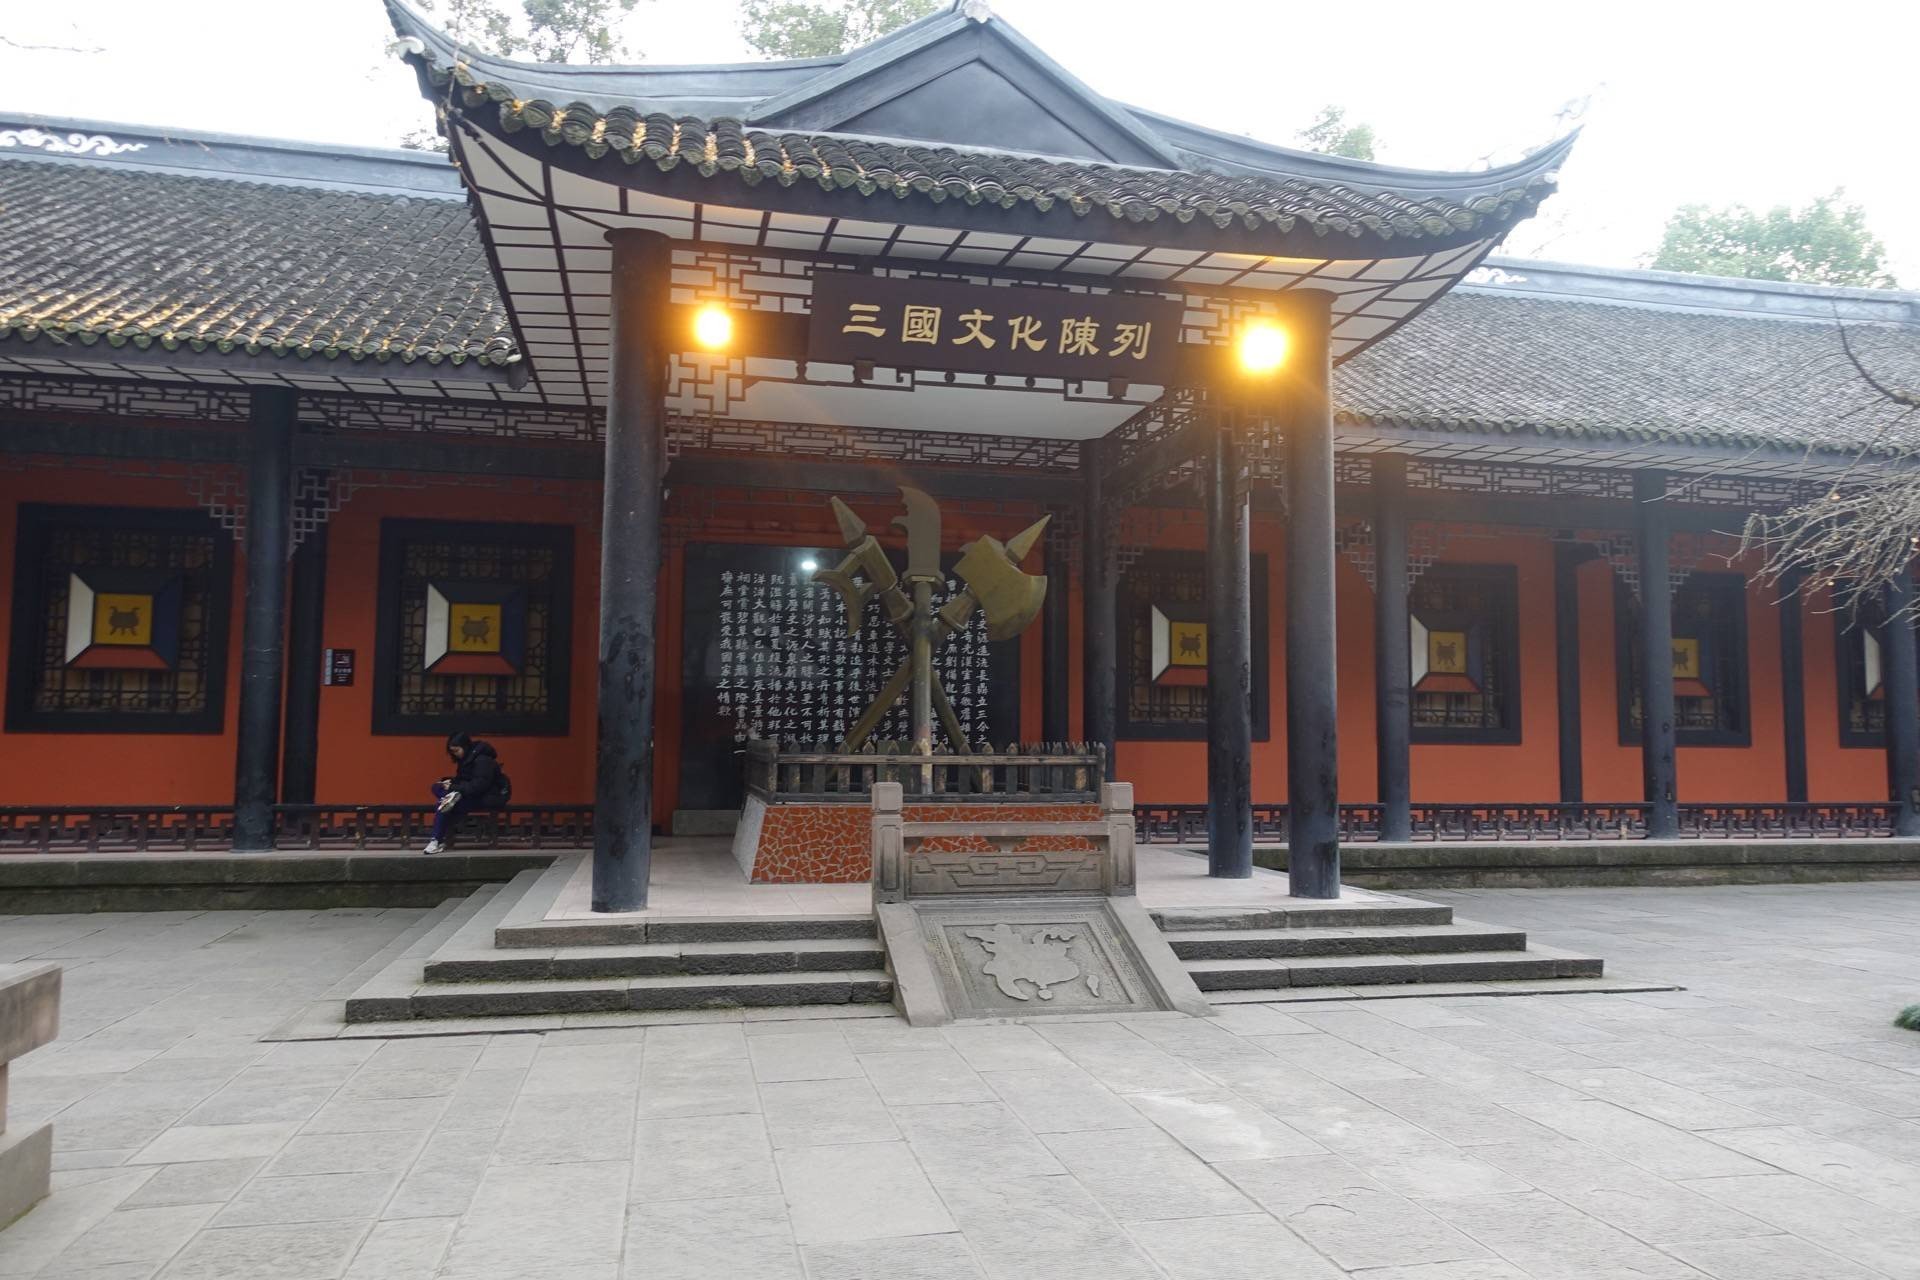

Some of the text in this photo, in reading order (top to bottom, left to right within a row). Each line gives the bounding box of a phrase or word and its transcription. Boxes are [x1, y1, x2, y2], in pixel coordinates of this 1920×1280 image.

[842, 303, 1152, 360] 三國文化陳列
